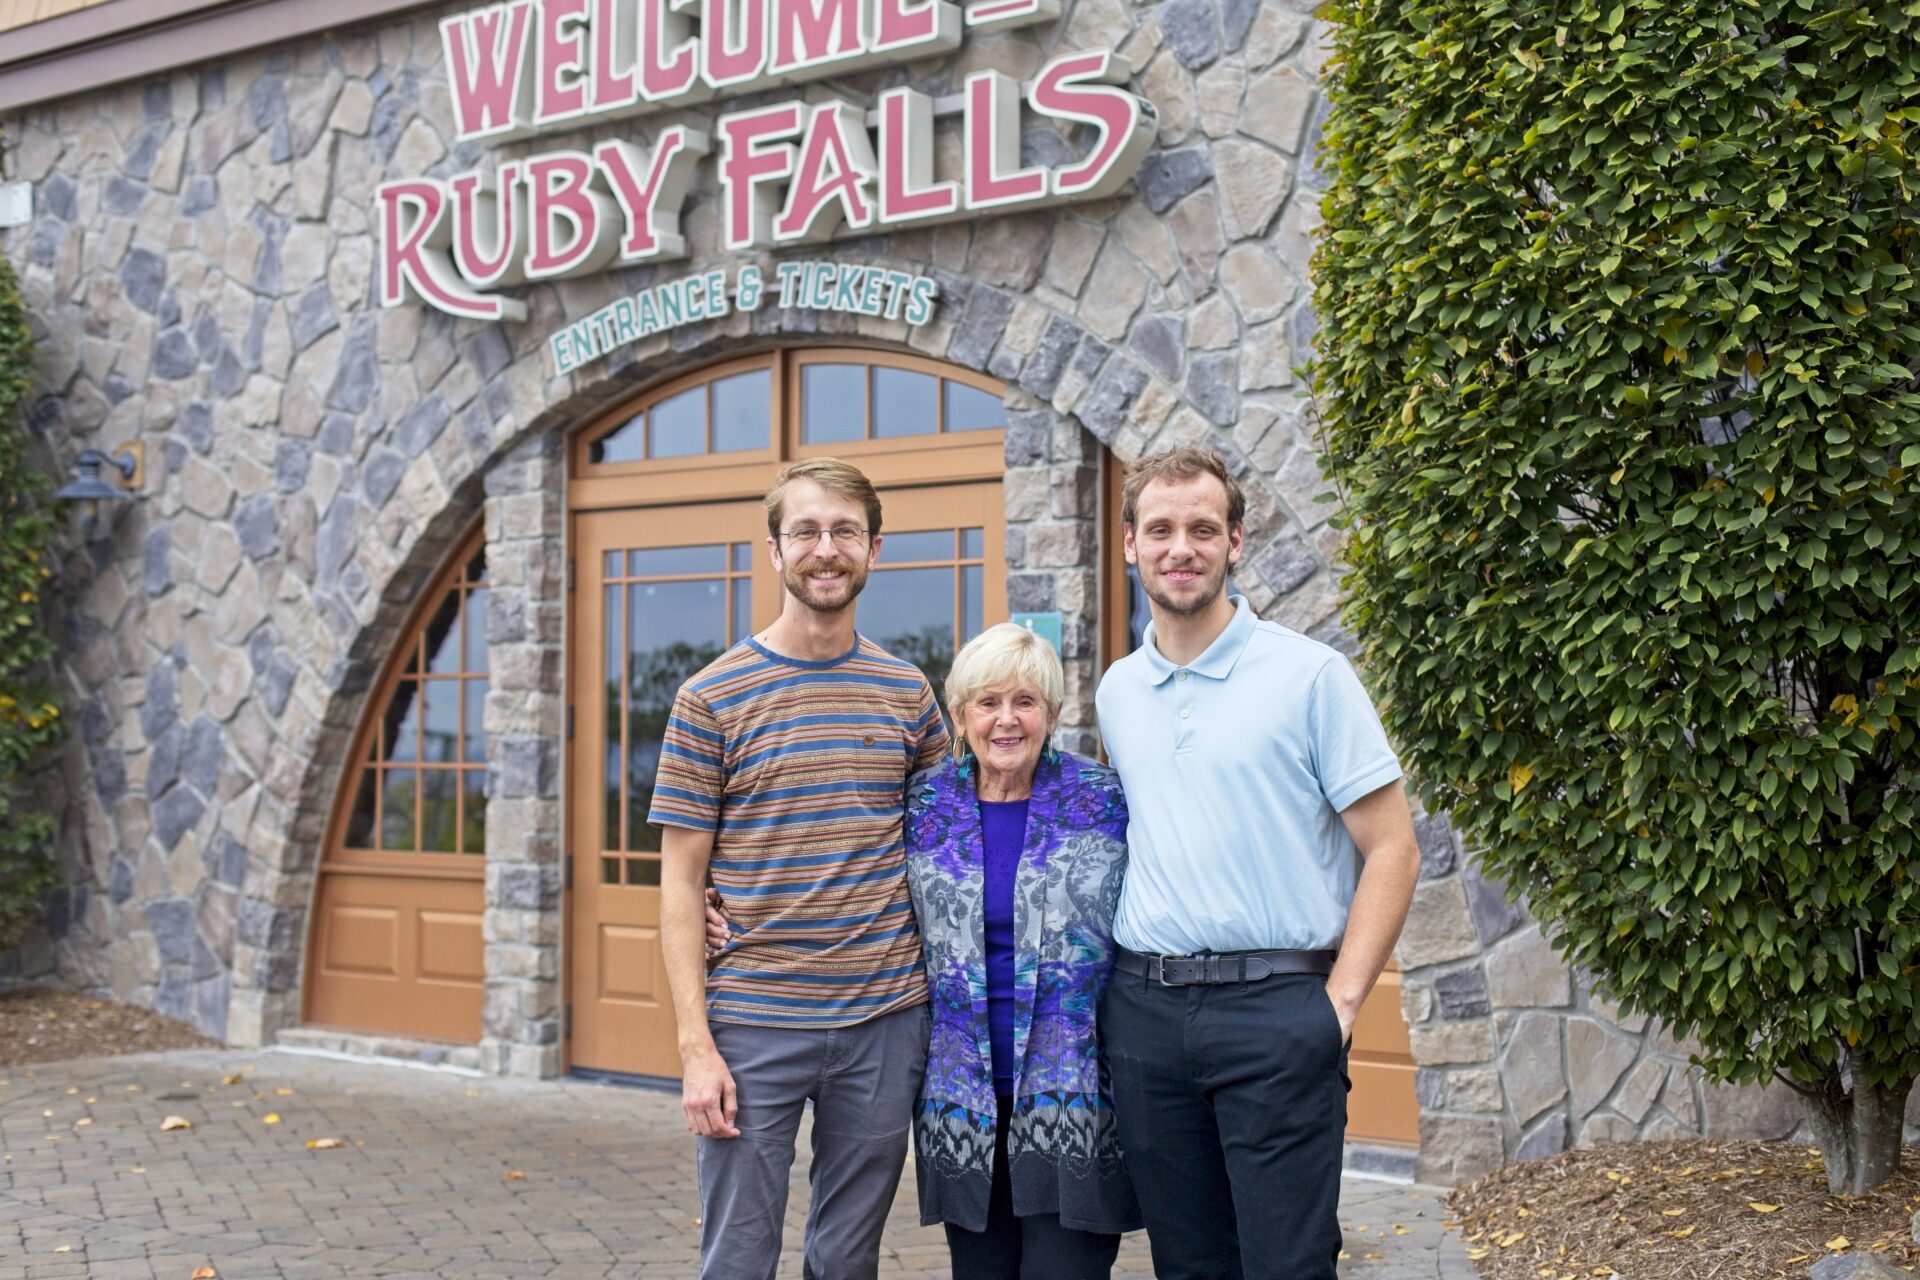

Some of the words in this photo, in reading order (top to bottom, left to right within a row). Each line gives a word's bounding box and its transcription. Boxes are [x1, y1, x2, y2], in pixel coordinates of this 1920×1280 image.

[374, 124, 688, 320] RUBY
[716, 47, 1139, 251] FALLS
[549, 268, 727, 377] ENTRANCE
[735, 264, 764, 312] &
[776, 260, 938, 326] TICKETS
